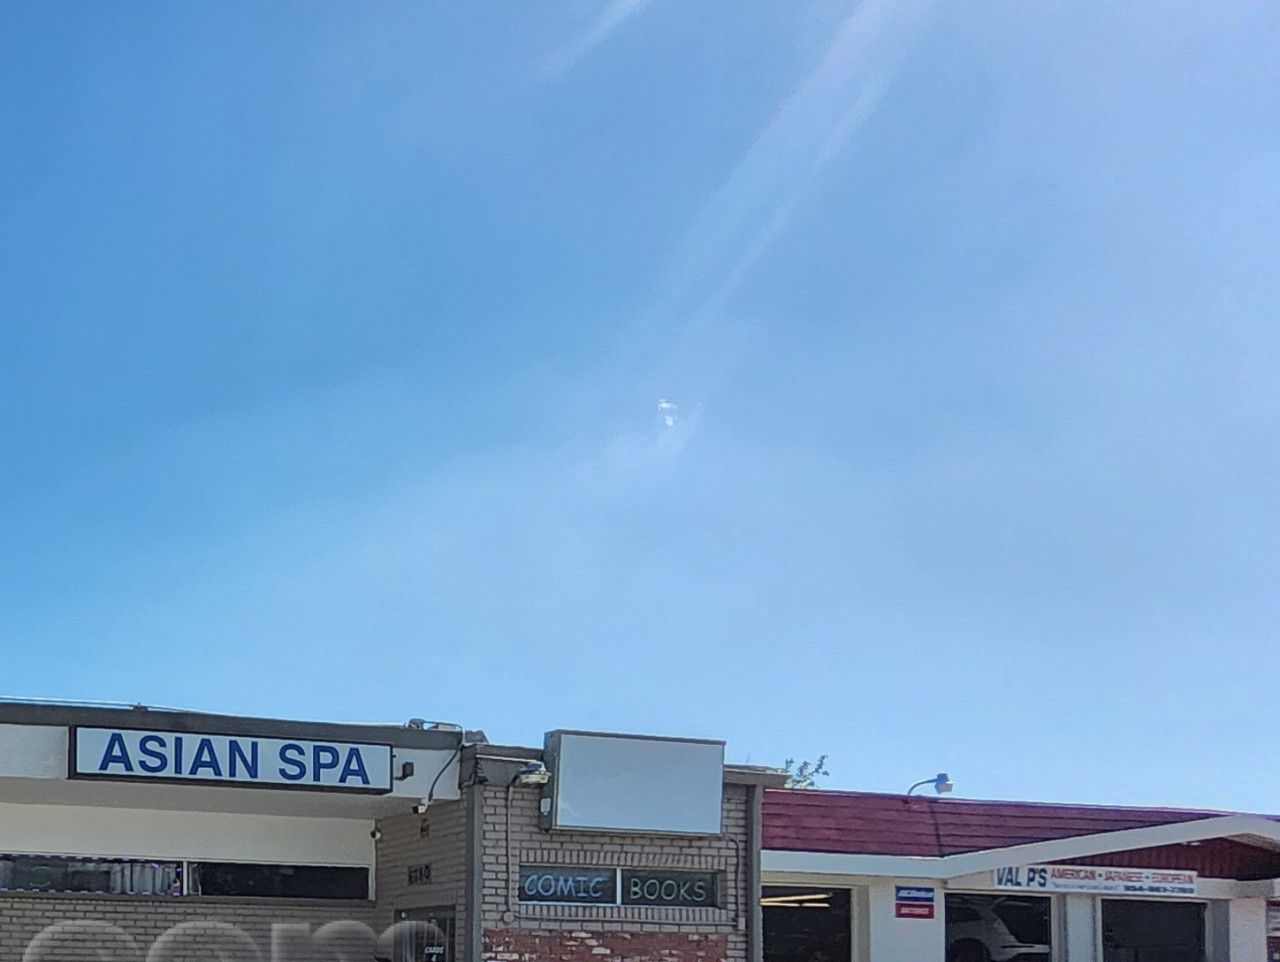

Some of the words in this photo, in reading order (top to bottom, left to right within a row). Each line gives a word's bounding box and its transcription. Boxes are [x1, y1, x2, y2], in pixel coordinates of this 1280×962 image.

[98, 732, 259, 780] ASIAN
[279, 741, 371, 786] SPA
[524, 873, 608, 899] COMIC
[630, 876, 707, 902] BOOKS
[996, 866, 1022, 887] VAL
